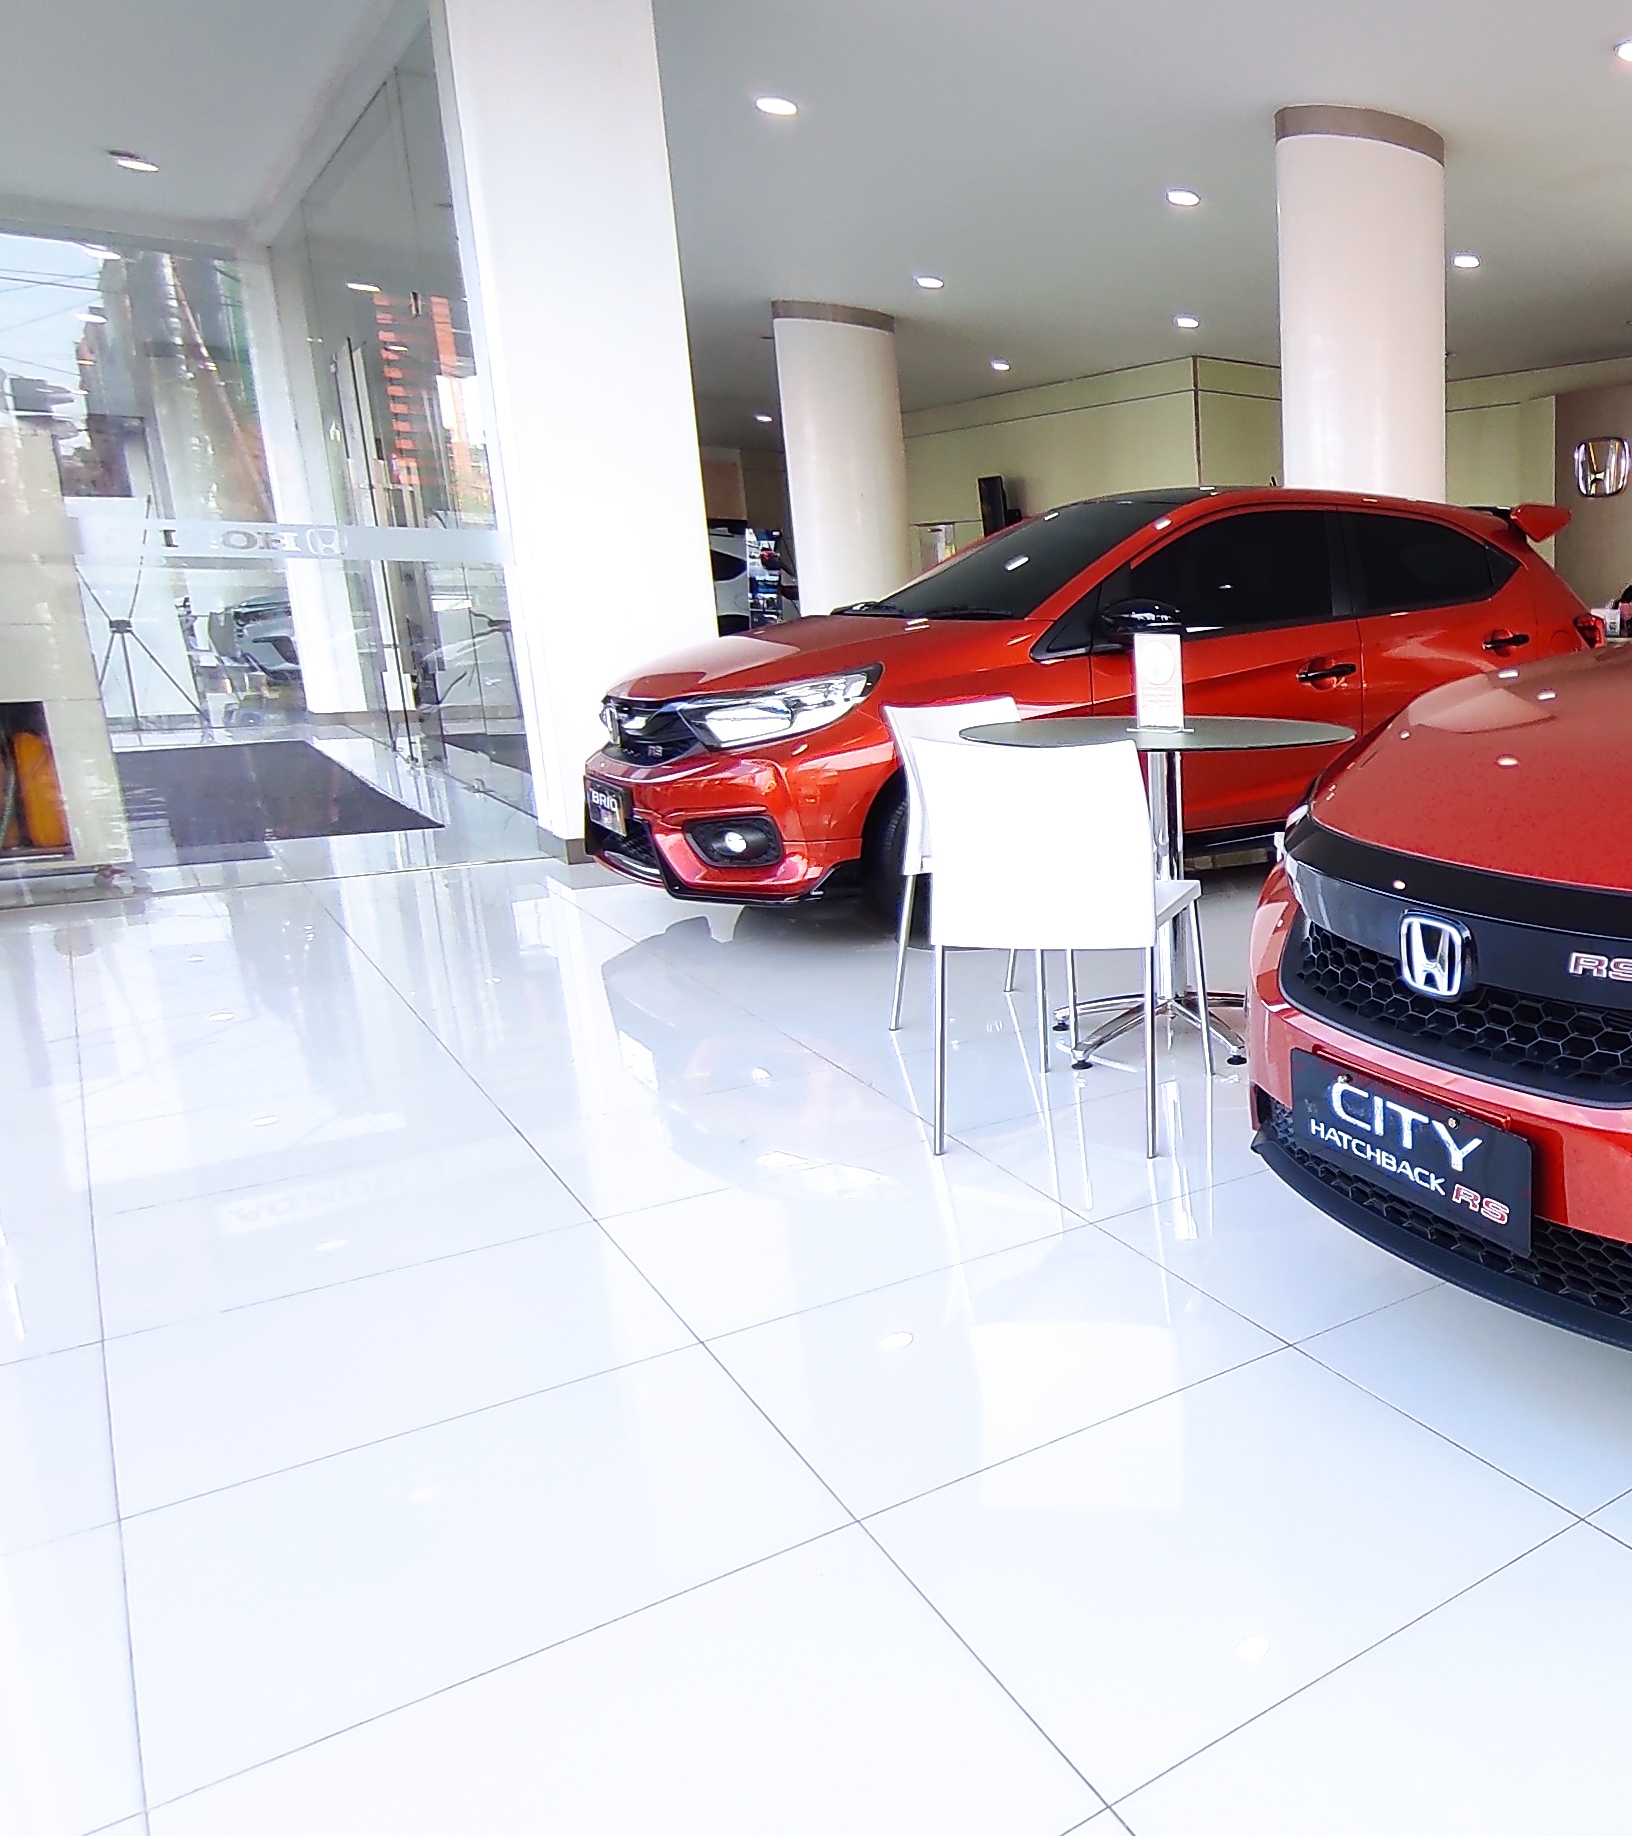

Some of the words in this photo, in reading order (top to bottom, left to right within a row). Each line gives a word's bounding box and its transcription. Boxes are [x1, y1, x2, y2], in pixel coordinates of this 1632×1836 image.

[591, 791, 618, 811] BRIO
[1310, 1118, 1446, 1197] HATCHBACK
[1452, 1183, 1511, 1225] RS
[1330, 1081, 1483, 1172] CITY
